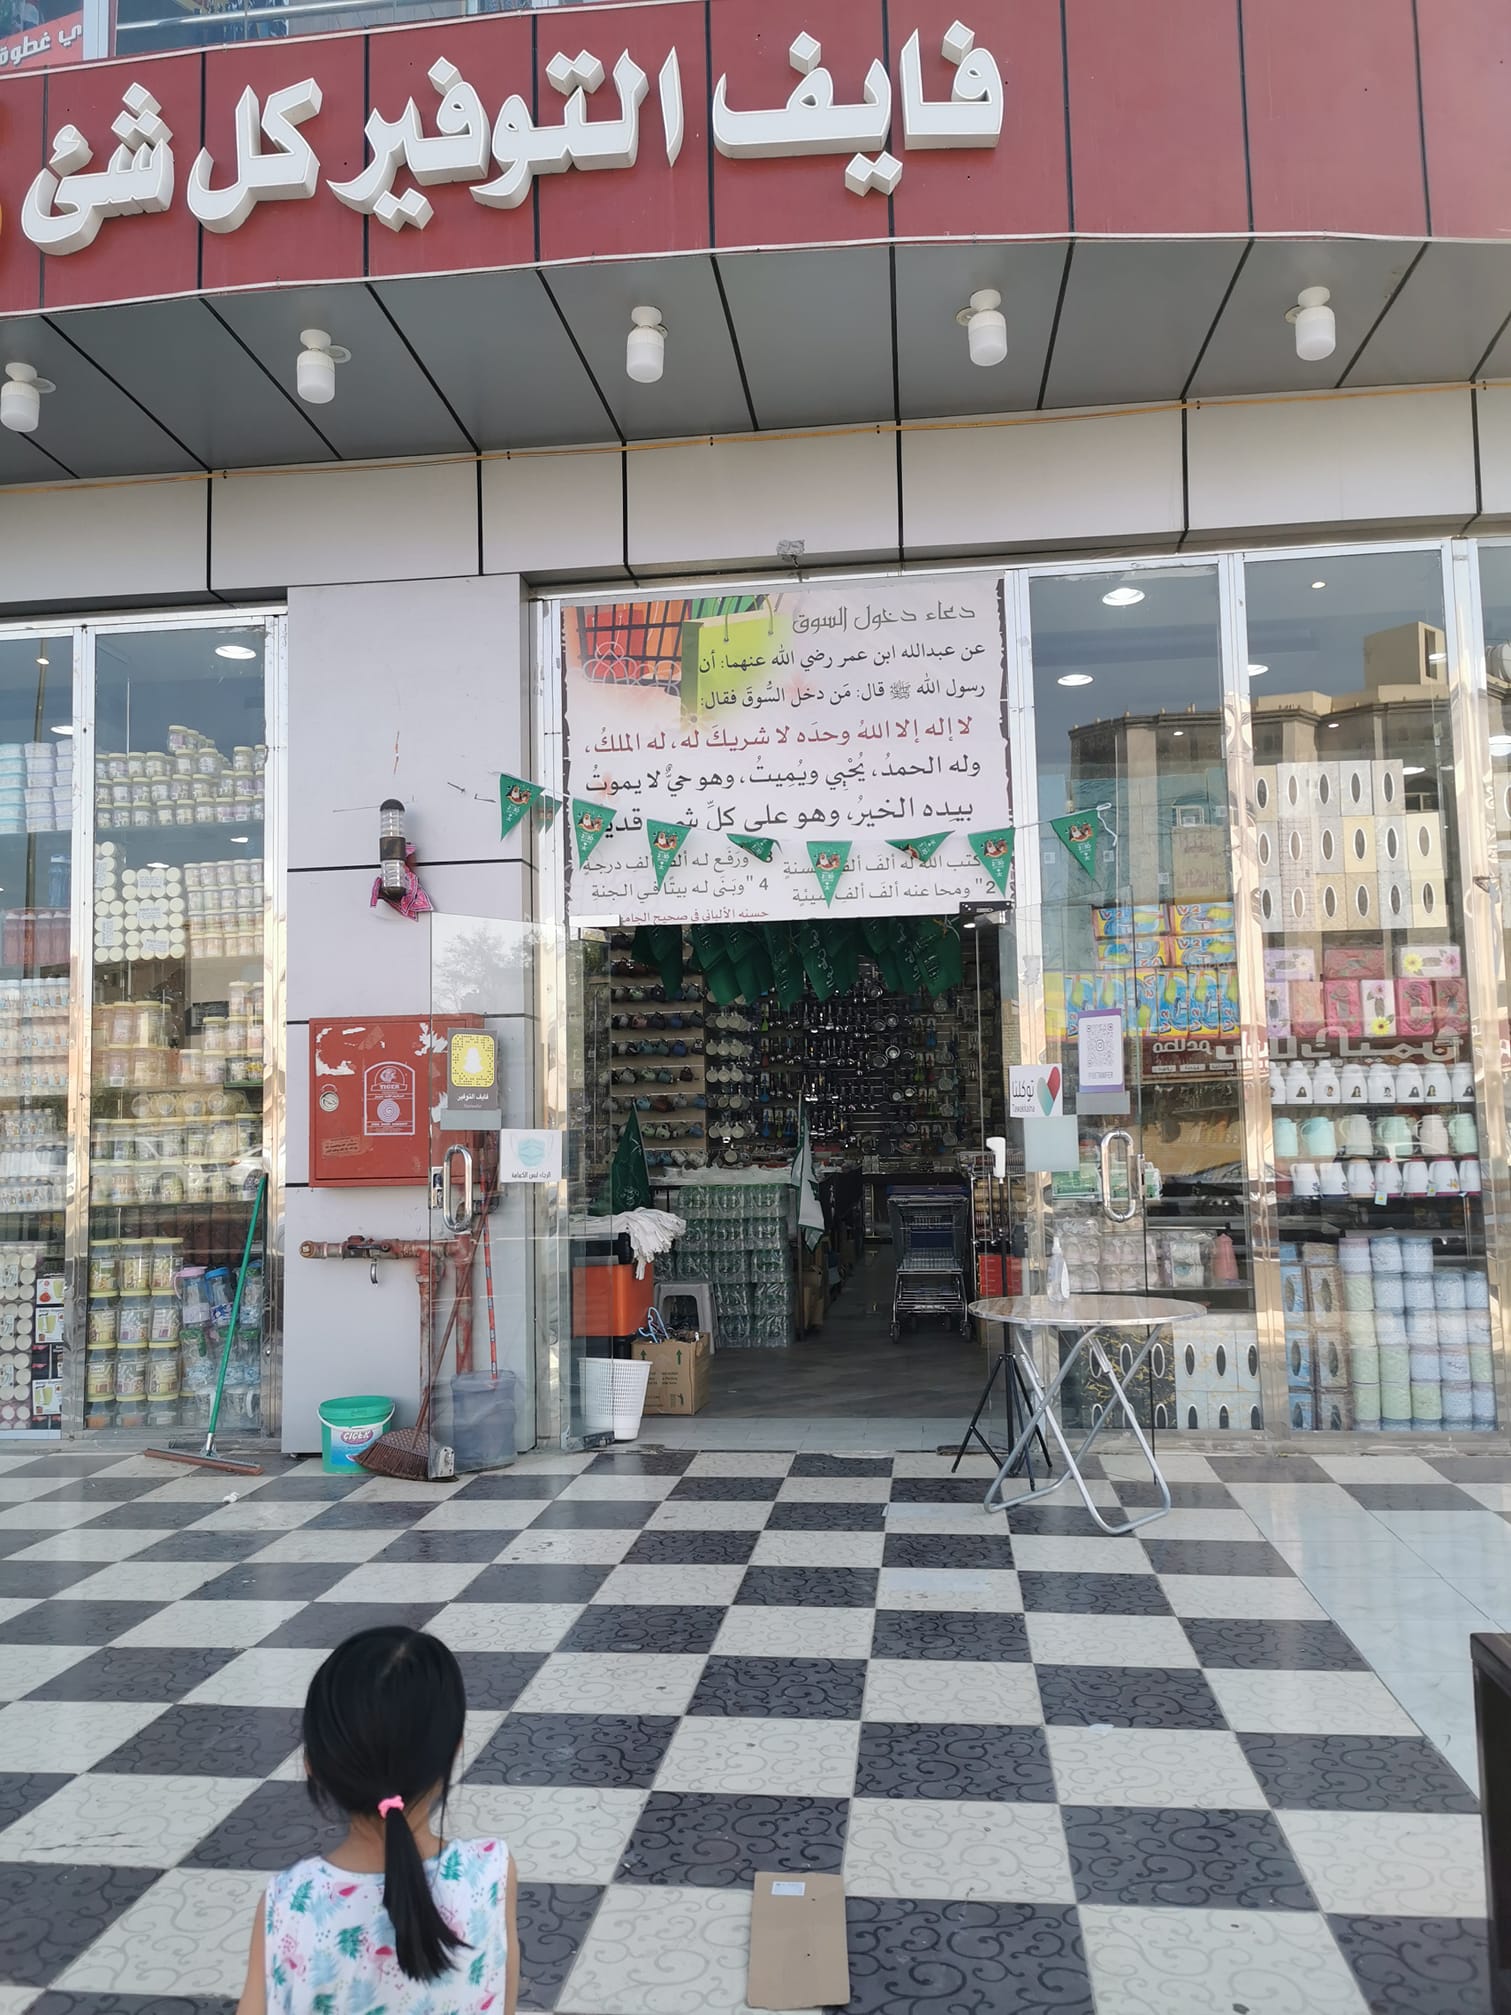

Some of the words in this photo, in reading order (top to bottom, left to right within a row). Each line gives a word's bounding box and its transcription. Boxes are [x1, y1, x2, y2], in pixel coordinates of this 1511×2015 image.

[712, 20, 1004, 197] فايف
[326, 46, 685, 233] التوفير
[187, 77, 323, 234] كل
[792, 605, 848, 635] السوق
[854, 604, 917, 632] دخول
[925, 600, 976, 622] دعاء
[800, 648, 834, 672] رضي
[836, 649, 868, 669] عمر
[873, 644, 896, 667] ابن
[900, 642, 956, 660] عبدالله
[960, 642, 986, 662] عن
[698, 650, 717, 674] أن
[720, 654, 767, 671] عنهما:
[790, 687, 825, 710] دخل
[856, 682, 886, 702] قال:
[945, 679, 986, 699] رسول
[700, 690, 738, 712] فقال:
[776, 725, 791, 744] لا
[896, 718, 918, 744] إلا
[924, 716, 953, 743] إله
[958, 715, 973, 736] لا
[646, 730, 666, 751] له
[949, 753, 981, 778] وله
[647, 769, 661, 790] لا
[695, 772, 735, 793] وهو
[605, 808, 643, 841] قدي
[744, 803, 789, 833] على
[793, 806, 841, 831] وهو
[691, 852, 709, 867] له
[900, 856, 915, 870] له
[946, 854, 982, 872] كتب
[637, 884, 660, 904] في
[691, 879, 709, 894] له
[759, 877, 769, 891] 4
[903, 884, 930, 898] عنه
[986, 880, 996, 895] 2
[621, 912, 650, 924] الجام
[653, 914, 688, 925] صحيح
[738, 908, 769, 919] حسنه
[1012, 1079, 1035, 1102] توكلنا
